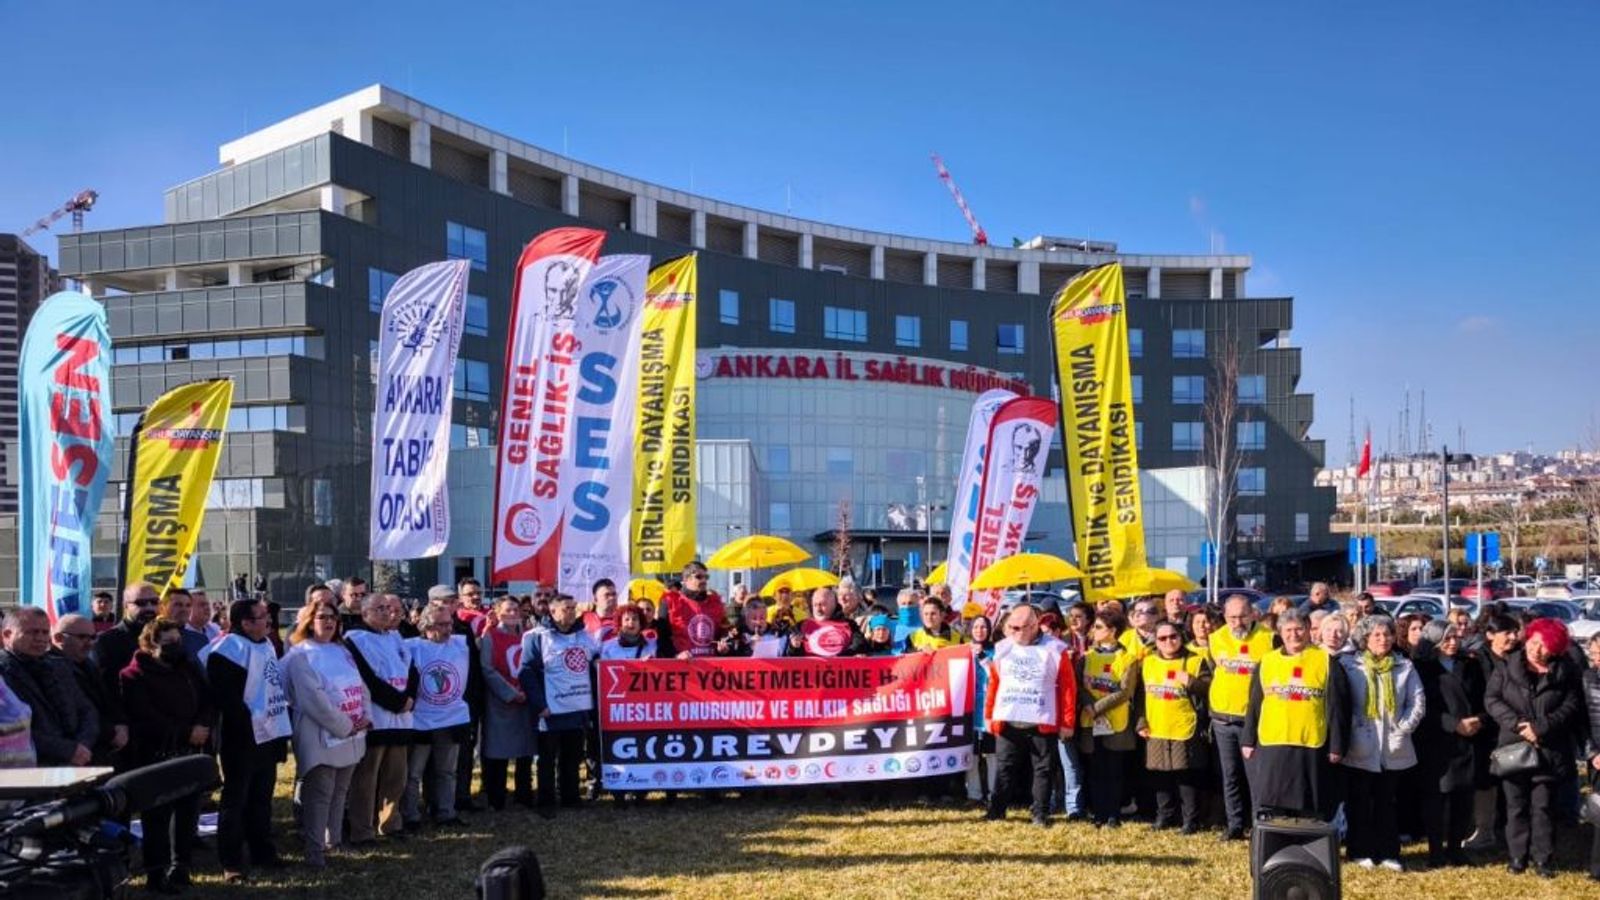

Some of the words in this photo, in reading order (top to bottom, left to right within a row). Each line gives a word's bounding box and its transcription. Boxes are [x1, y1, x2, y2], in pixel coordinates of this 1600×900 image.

[385, 373, 442, 415] ANKARA
[641, 327, 671, 454] DAYANIŞMA
[715, 356, 830, 379] ANKARA
[836, 352, 860, 381] İL
[865, 357, 947, 388] SAĞLIK
[507, 357, 539, 466] GENEL
[533, 332, 583, 500] SAĞLIK-İŞ
[570, 351, 618, 533] SES
[669, 386, 691, 504] SENDİKASI
[1069, 343, 1106, 478] DAYANIŞMA
[646, 460, 664, 482] ve
[1090, 481, 1106, 508] ve
[1108, 402, 1137, 525] SENDİKASI
[635, 489, 665, 563] BİRLİK
[977, 503, 1005, 571] ENEL
[1082, 511, 1115, 591] BİRLİK
[610, 702, 674, 723] MESLEK
[679, 700, 766, 722] ONURUMUZ
[770, 700, 789, 720] VE
[794, 699, 847, 719] HALKIN
[853, 689, 911, 716] SAĞLIĞI
[915, 688, 947, 716] İÇİN
[696, 665, 872, 692] YÖNETMELİĞİNE
